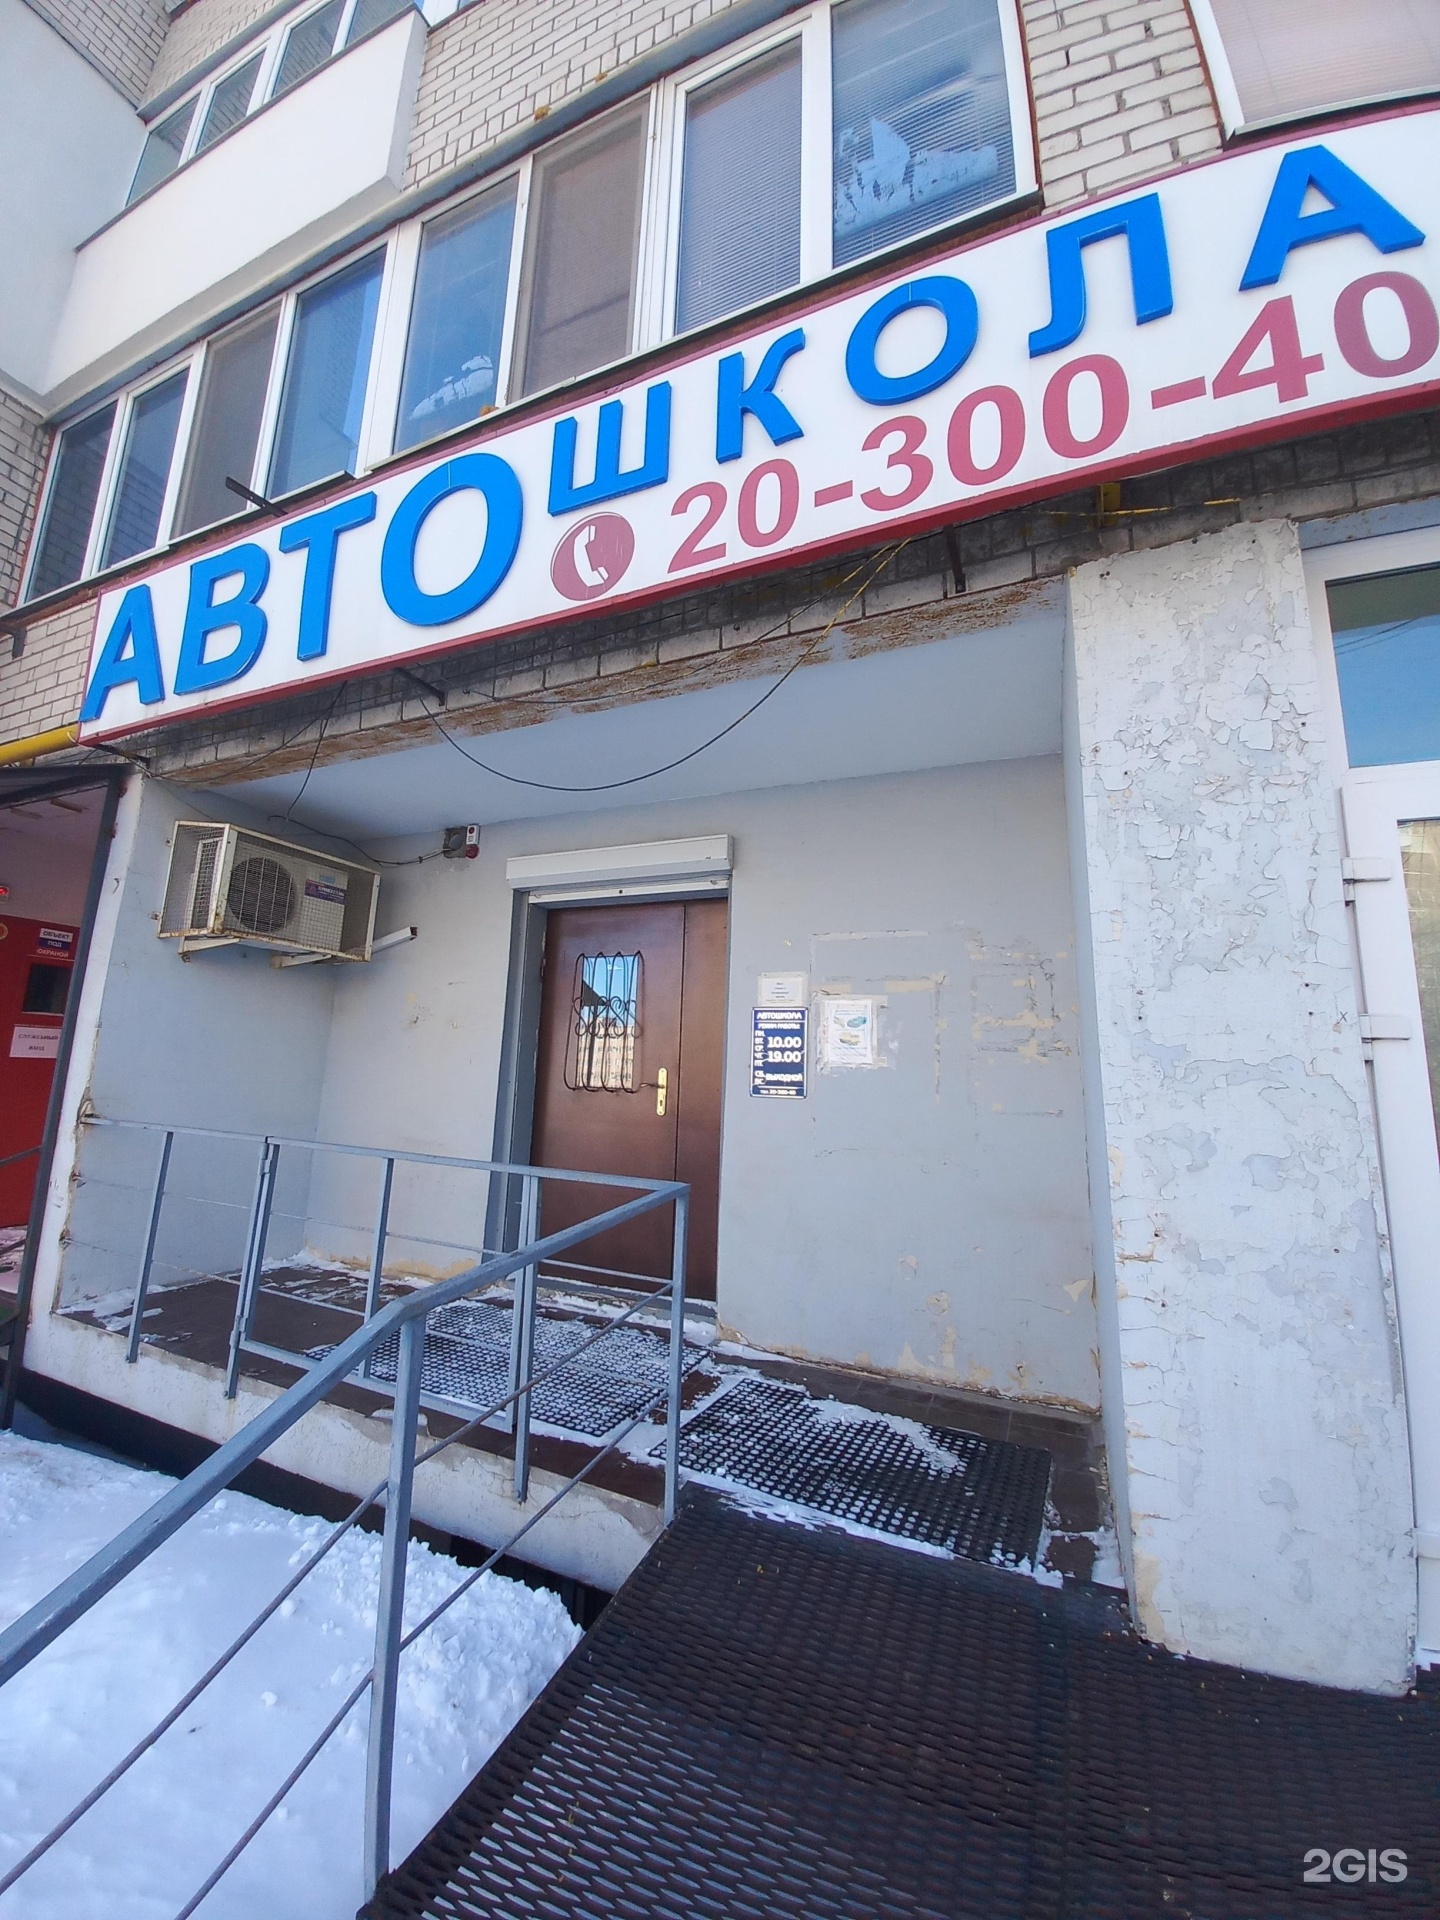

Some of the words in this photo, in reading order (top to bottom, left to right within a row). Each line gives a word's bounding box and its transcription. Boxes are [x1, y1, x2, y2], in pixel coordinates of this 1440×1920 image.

[667, 271, 1440, 574] 20-300-40
[79, 144, 1426, 723] АВТОШКОЛА
[42, 930, 70, 940] ОБЪЕКТ
[47, 940, 63, 948] ПОД
[37, 948, 69, 958] ОХРАНОЙ
[756, 1011, 803, 1020] АВТОШКОЛА
[767, 1036, 802, 1049] 10.00
[767, 1050, 802, 1063] 19.00
